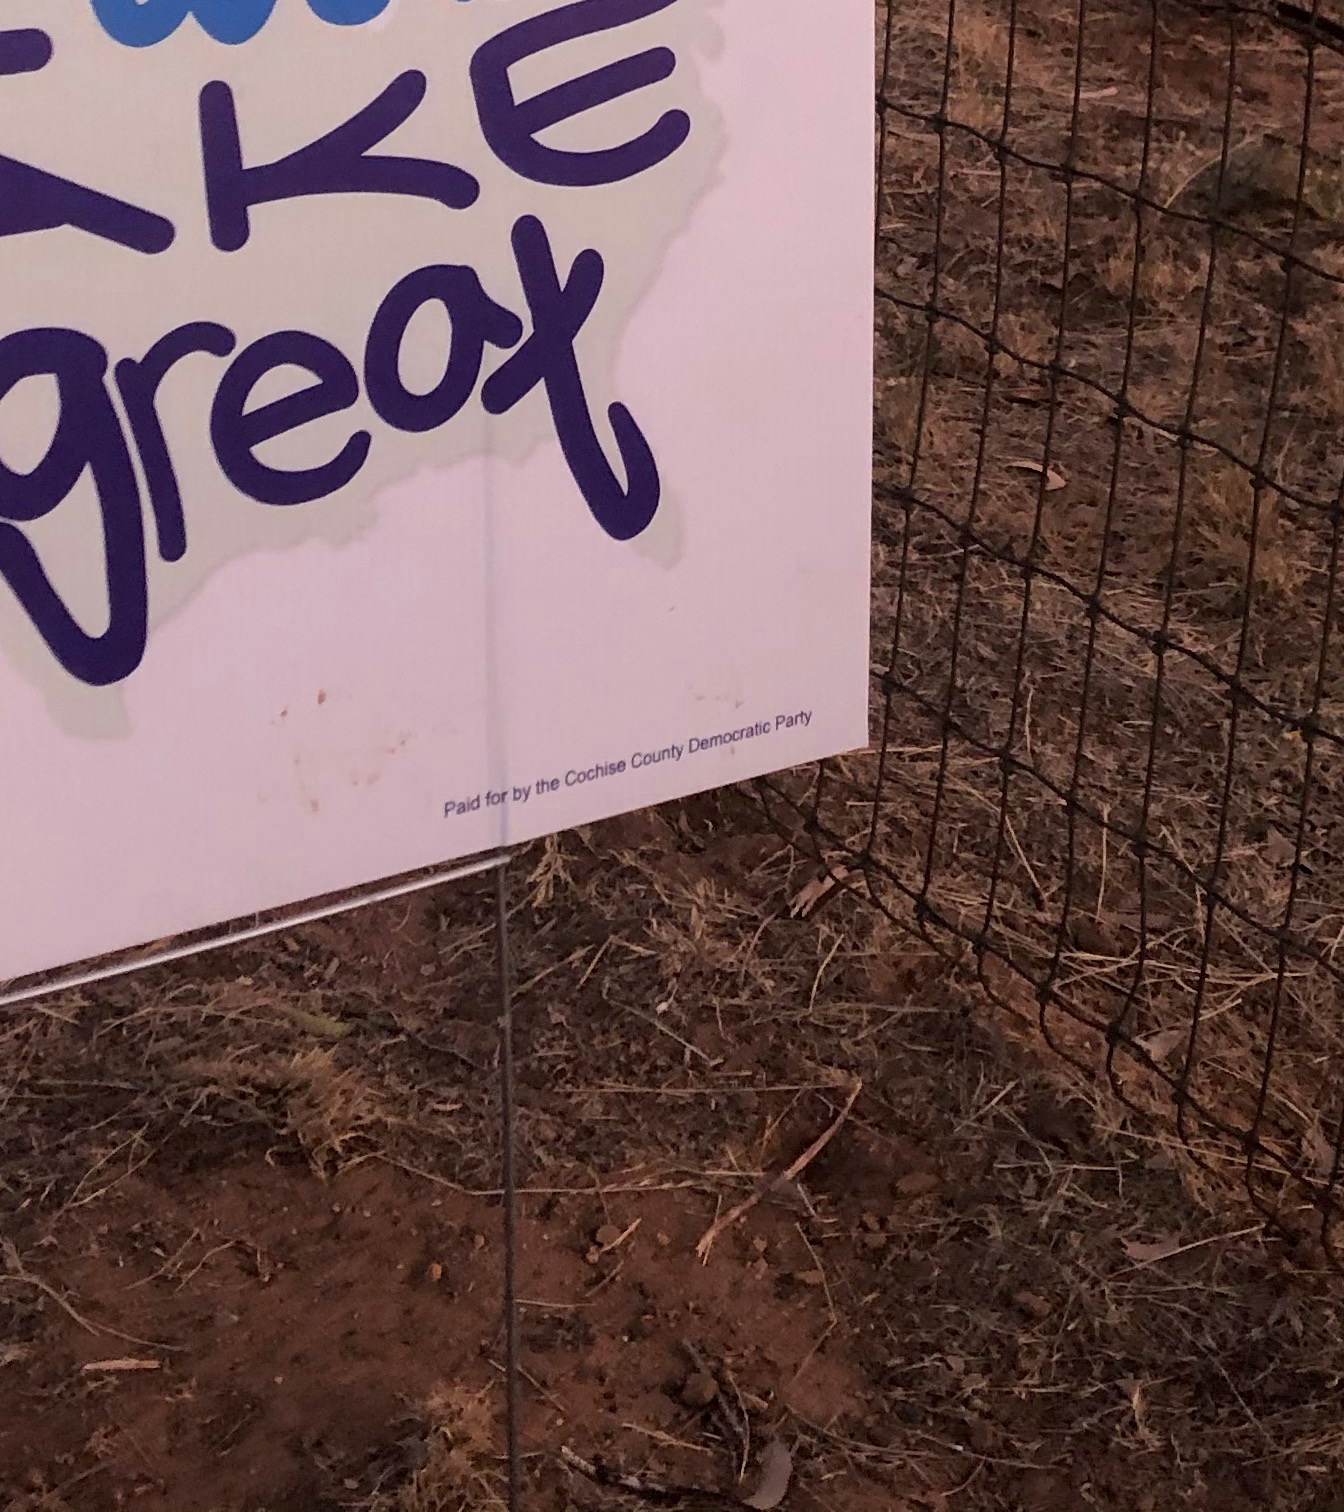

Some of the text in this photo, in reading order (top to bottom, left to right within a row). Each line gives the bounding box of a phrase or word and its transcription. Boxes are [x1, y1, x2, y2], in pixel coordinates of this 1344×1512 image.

[443, 709, 814, 818] Paid for by the Cochise County Democratic Party
